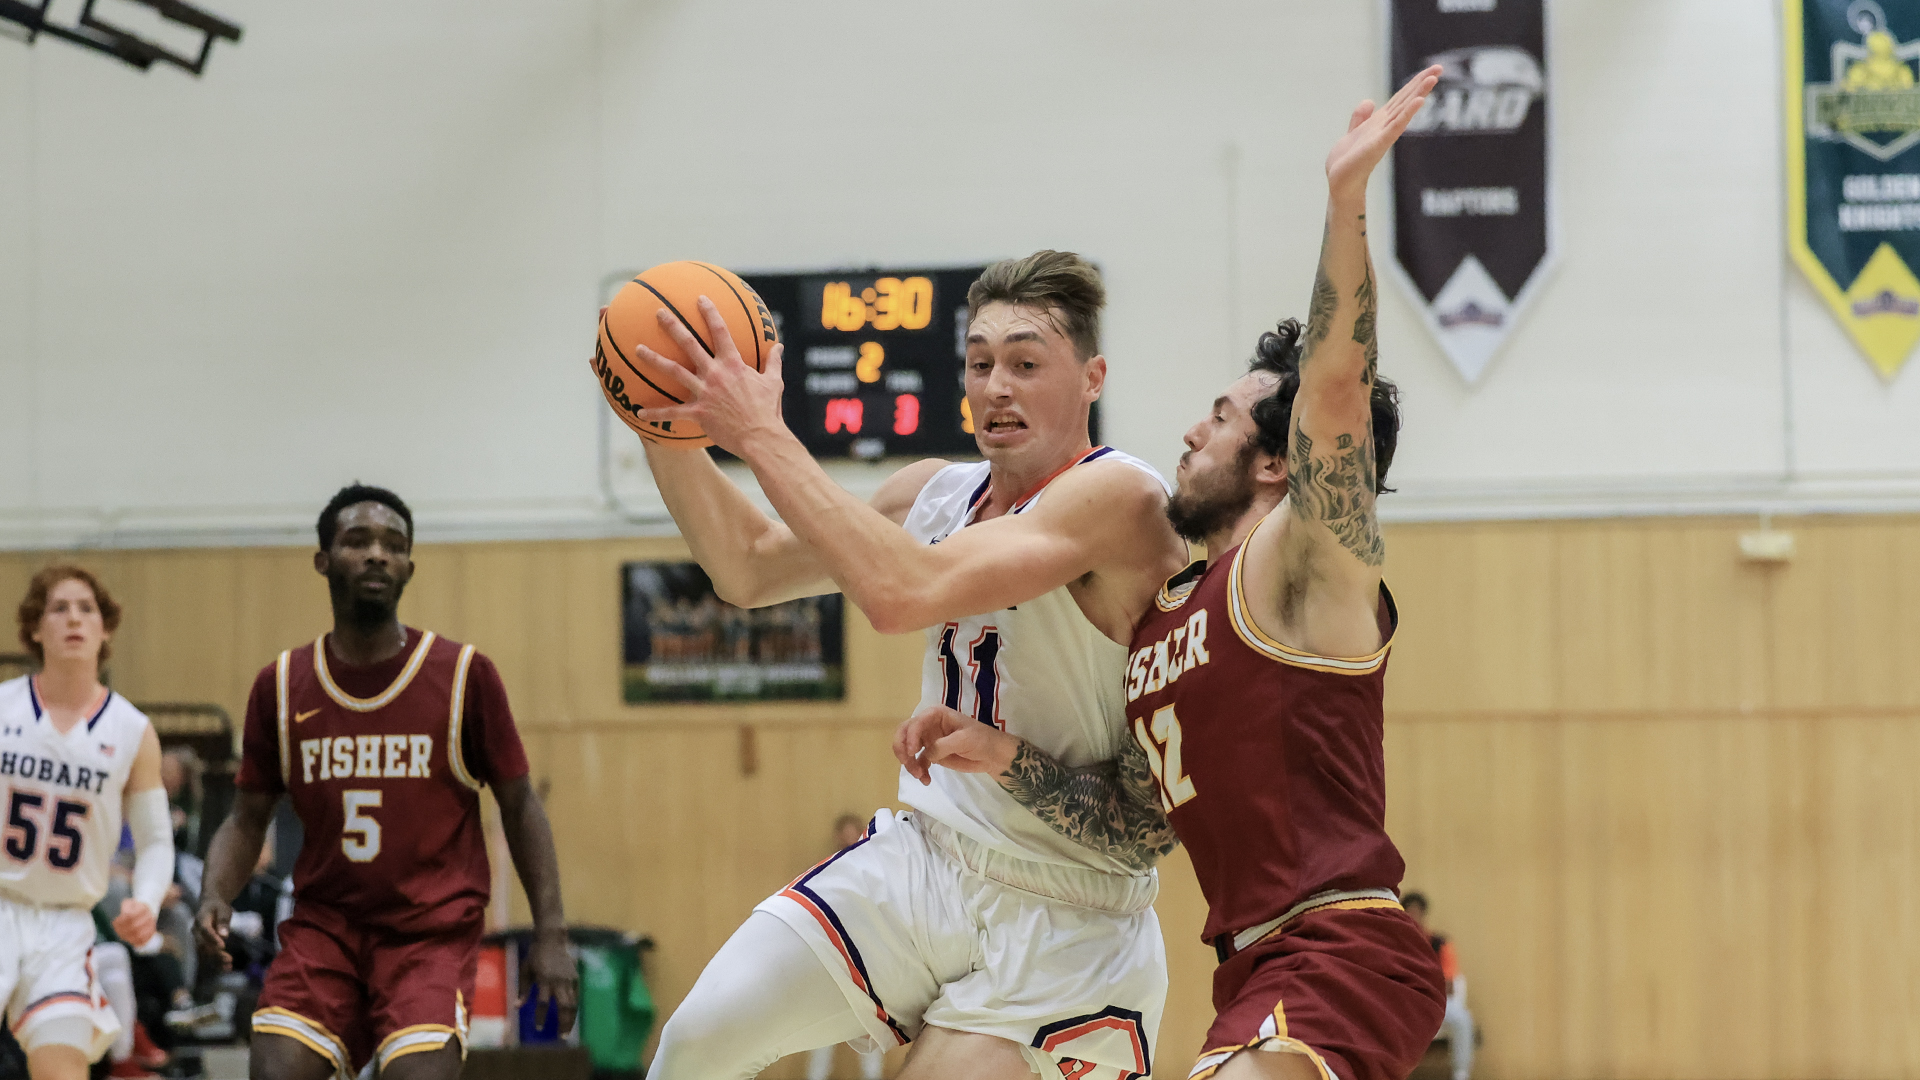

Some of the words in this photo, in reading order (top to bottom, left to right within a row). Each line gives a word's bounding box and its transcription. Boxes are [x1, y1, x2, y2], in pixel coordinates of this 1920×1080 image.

[937, 622, 1006, 733] 11
[0, 751, 109, 795] HOBART
[300, 734, 433, 784] FISHER
[6, 786, 91, 871] 55
[341, 789, 382, 863] 5
